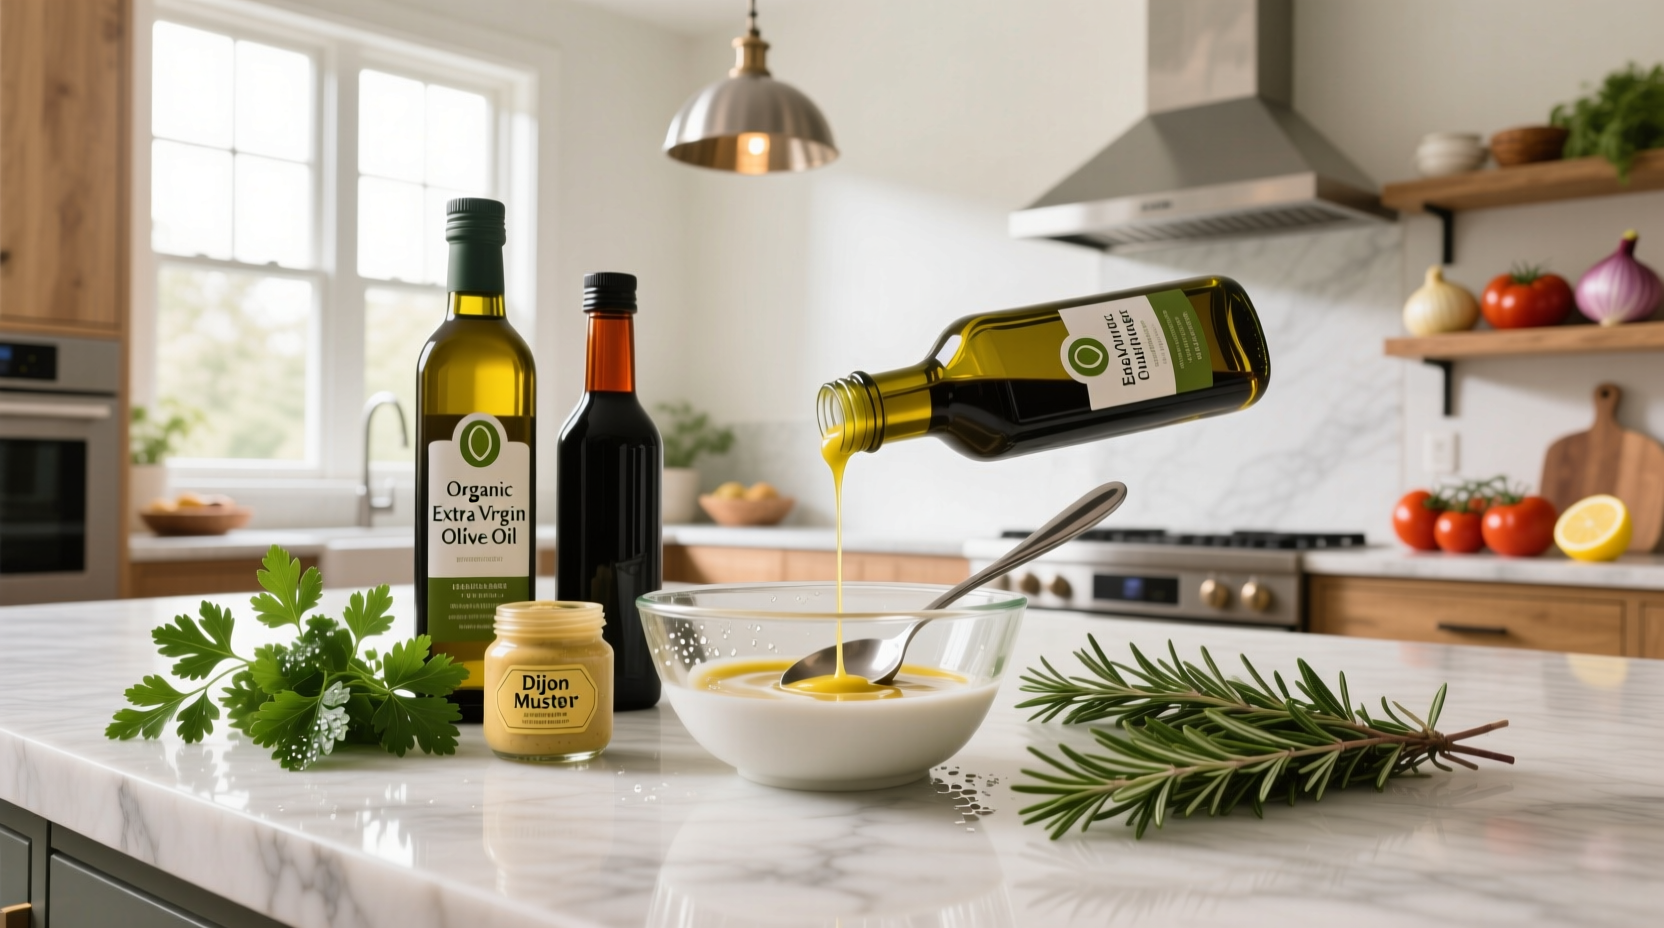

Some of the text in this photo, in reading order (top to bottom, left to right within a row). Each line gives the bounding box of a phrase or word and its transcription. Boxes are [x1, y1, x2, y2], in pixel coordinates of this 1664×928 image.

[446, 480, 514, 503] Organic
[432, 505, 476, 522] Extra
[441, 526, 517, 545] Olive Oil
[522, 674, 570, 696] Dijon
